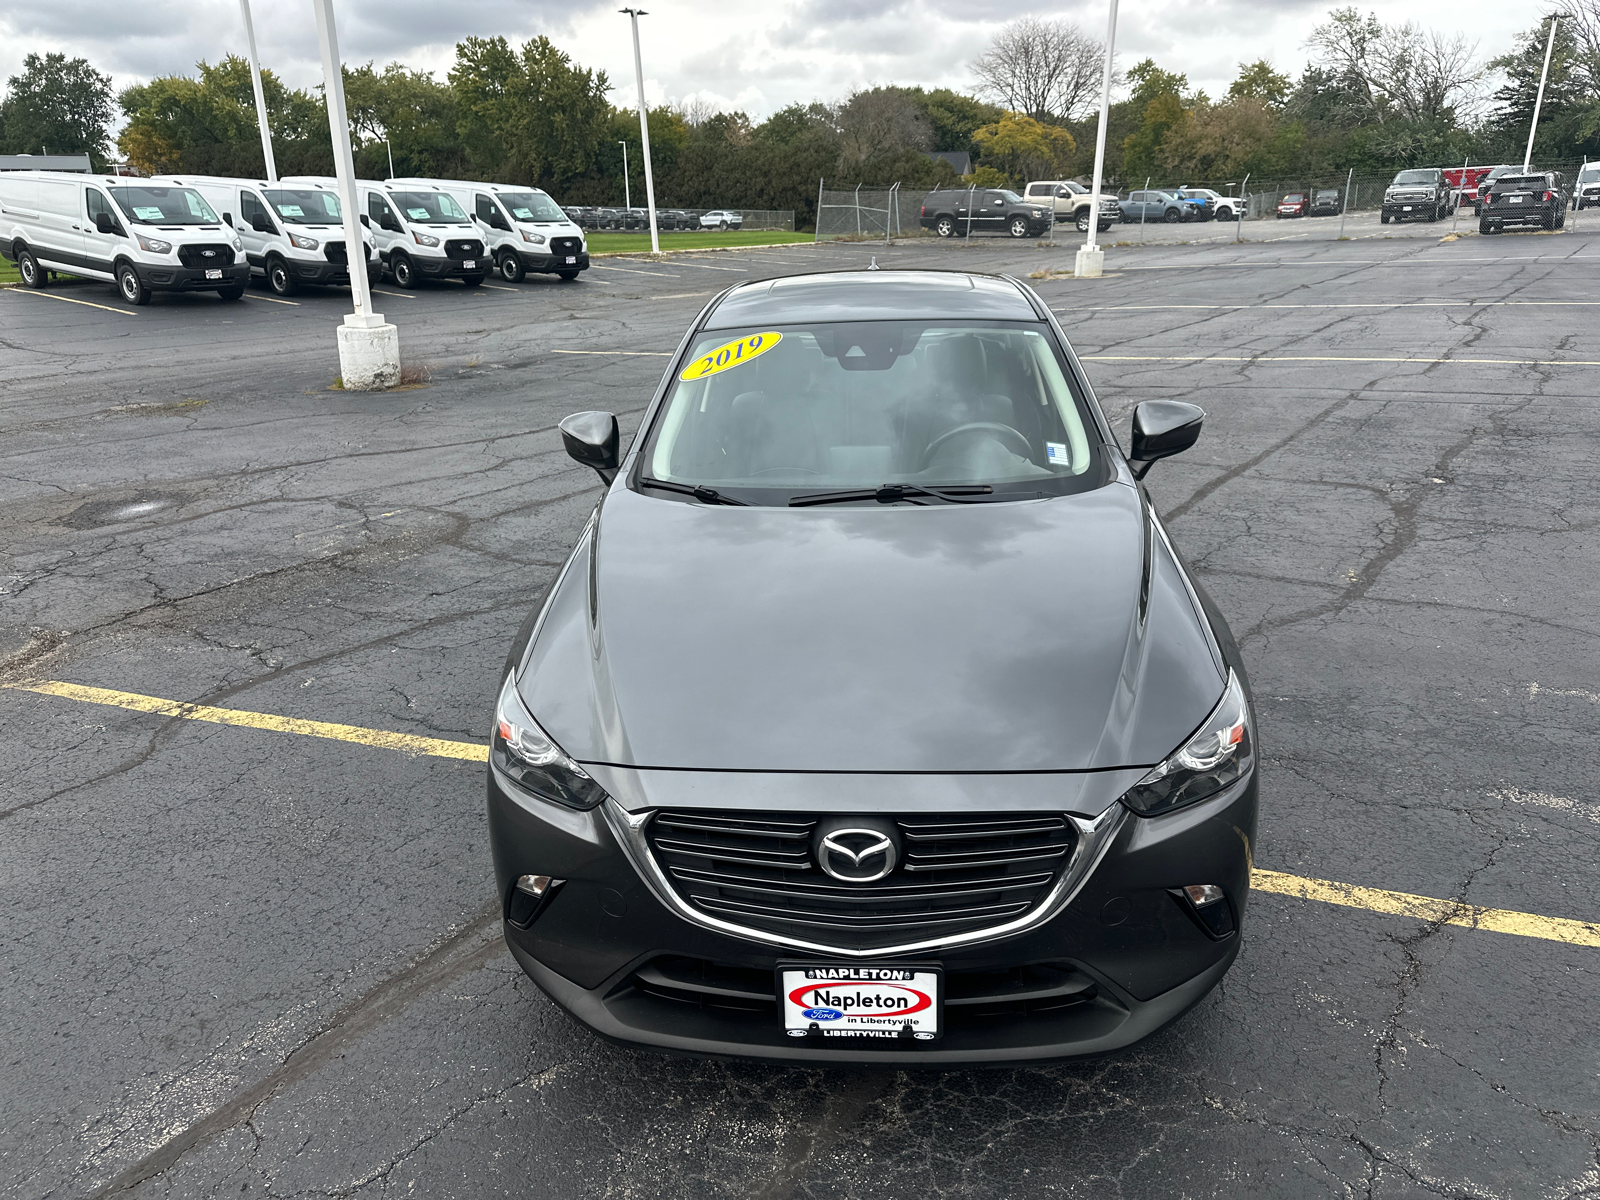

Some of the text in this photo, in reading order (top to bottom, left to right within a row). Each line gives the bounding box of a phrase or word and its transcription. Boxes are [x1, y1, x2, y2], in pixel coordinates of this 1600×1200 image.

[700, 336, 763, 375] 2019
[815, 969, 904, 980] NAPLETON
[814, 990, 908, 1010] Napleton
[811, 1010, 835, 1019] Ford
[860, 1017, 920, 1026] Libertyville
[823, 1030, 899, 1038] LIBERTYVILLE
